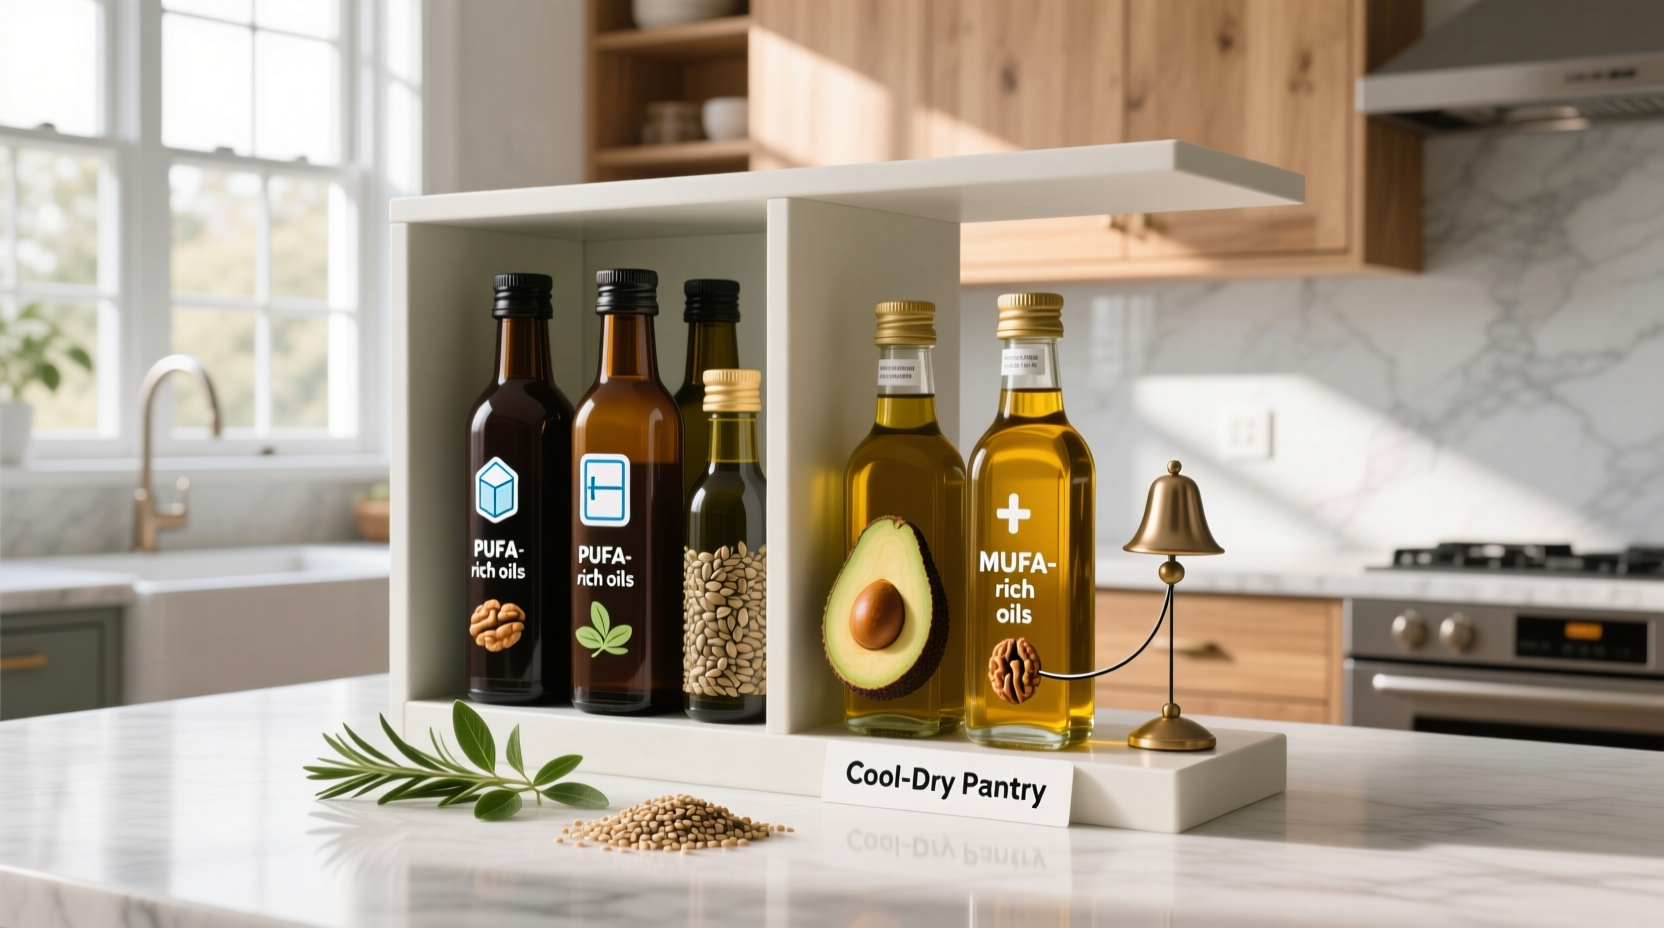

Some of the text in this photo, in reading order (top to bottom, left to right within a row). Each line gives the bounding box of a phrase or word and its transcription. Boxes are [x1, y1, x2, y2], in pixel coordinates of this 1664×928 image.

[473, 539, 525, 559] PUFA-
[578, 545, 632, 565] PUFA-
[471, 561, 526, 579] rich oils
[979, 550, 1057, 575] MUFA-
[576, 568, 635, 588] rich oils
[995, 577, 1035, 599] rich
[996, 603, 1032, 624] oils
[846, 760, 1047, 809] Cool-Dry Pantry
